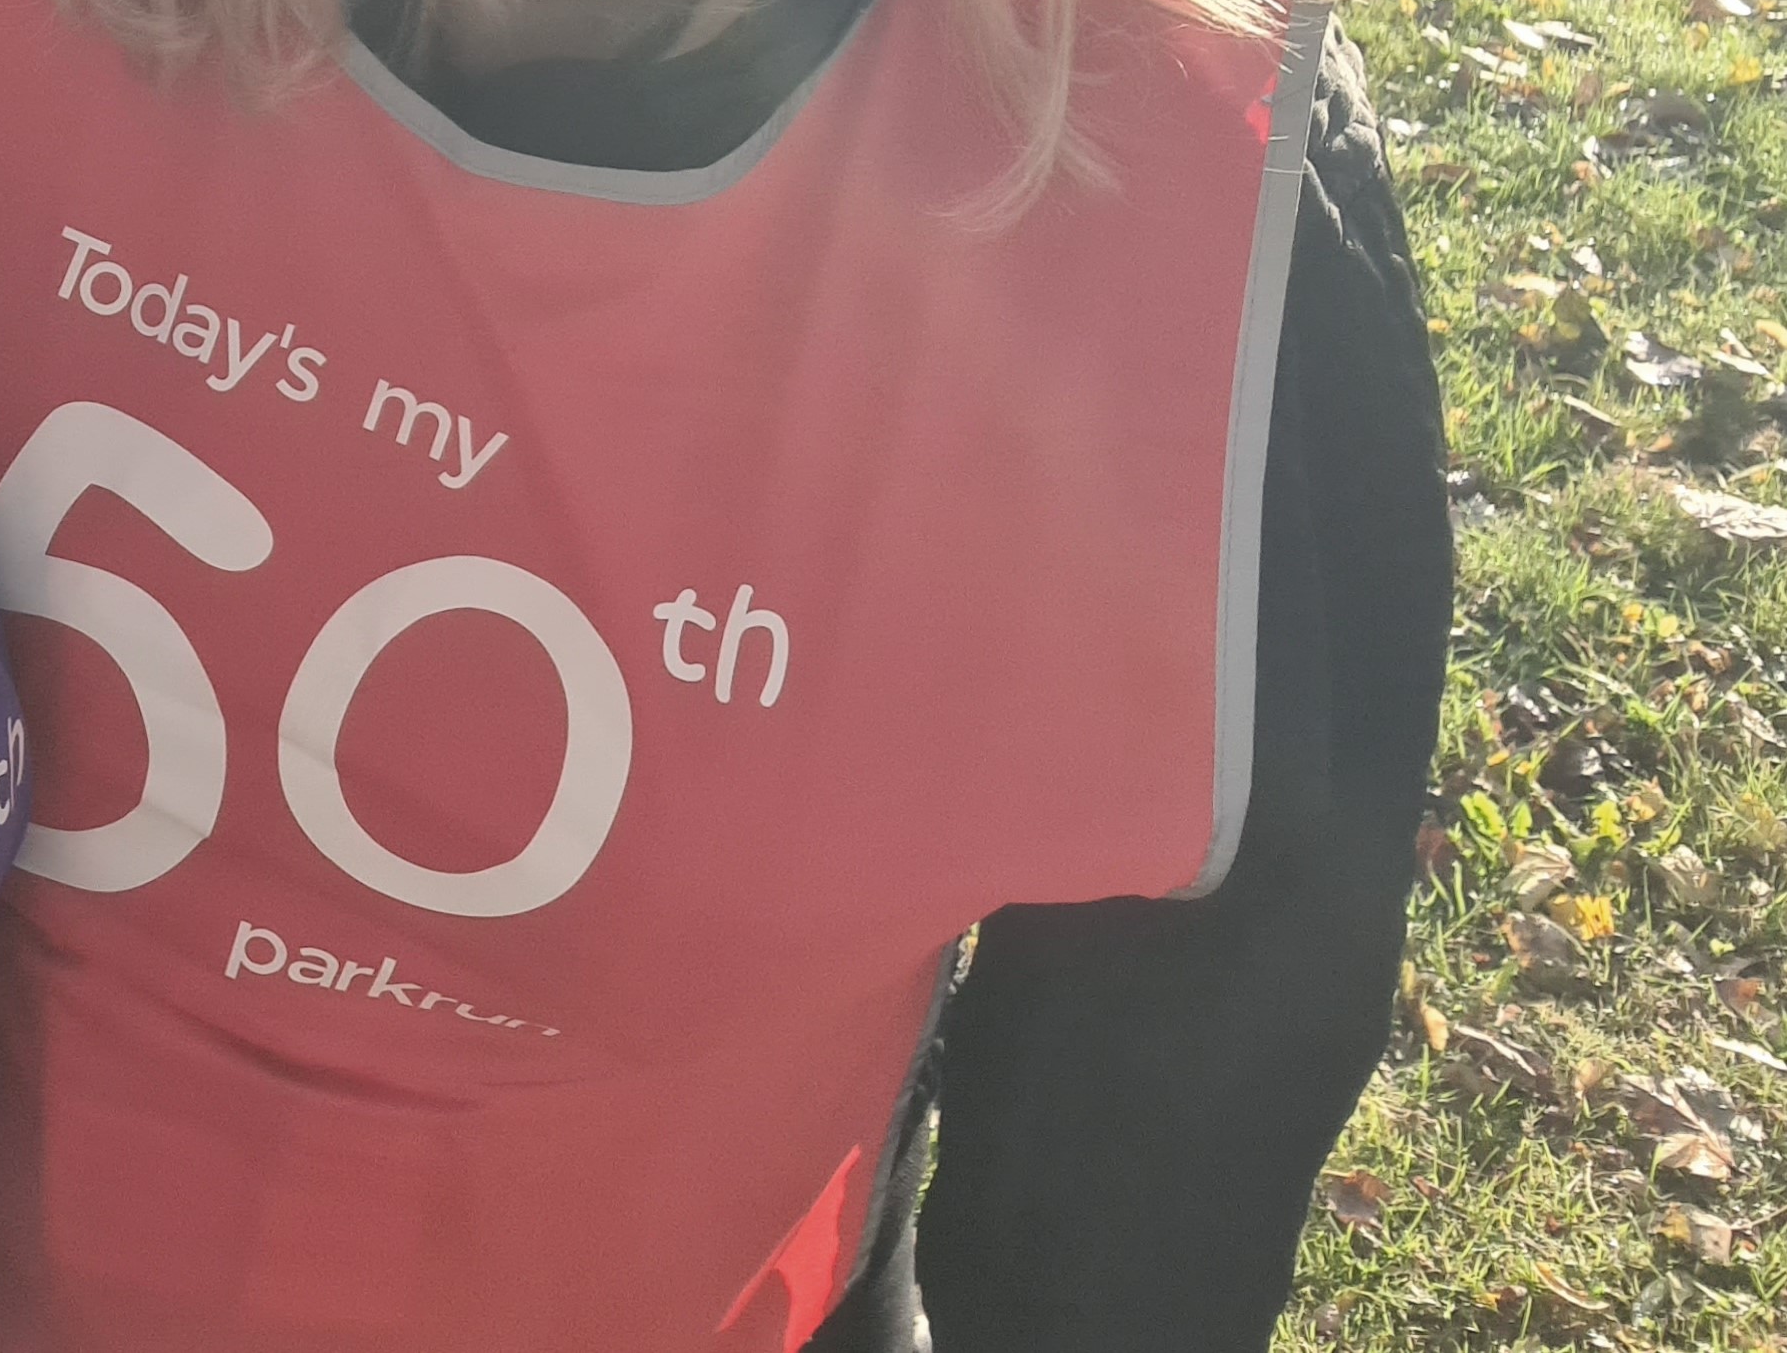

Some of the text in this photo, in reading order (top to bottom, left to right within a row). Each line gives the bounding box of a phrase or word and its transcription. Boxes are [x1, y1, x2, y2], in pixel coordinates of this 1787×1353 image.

[58, 226, 511, 491] Today's my
[223, 920, 562, 1038] parkrun
